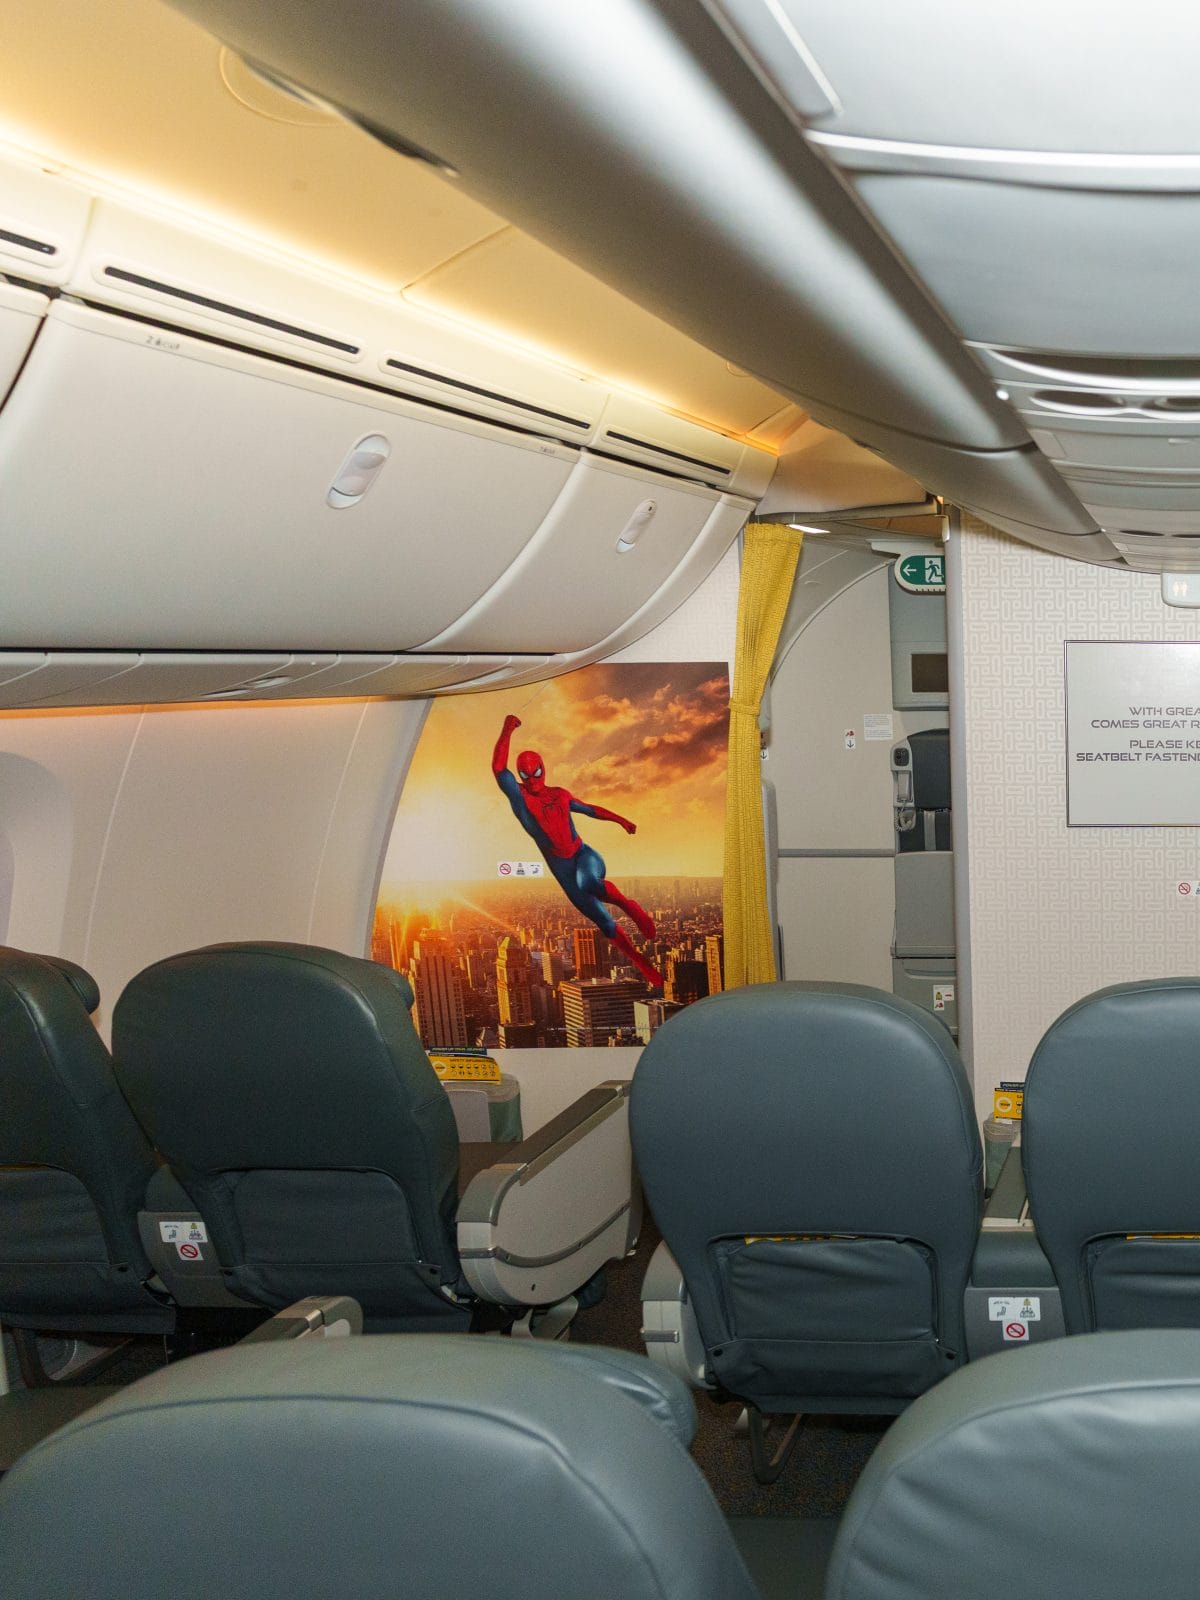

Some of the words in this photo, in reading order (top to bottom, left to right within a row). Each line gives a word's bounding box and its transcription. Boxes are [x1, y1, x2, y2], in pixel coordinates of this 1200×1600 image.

[1128, 706, 1162, 717] WITH
[1090, 719, 1140, 729] COMES
[1142, 719, 1188, 729] GREAT
[1129, 739, 1183, 749] PLEASE
[1076, 752, 1143, 762] SEATBELT
